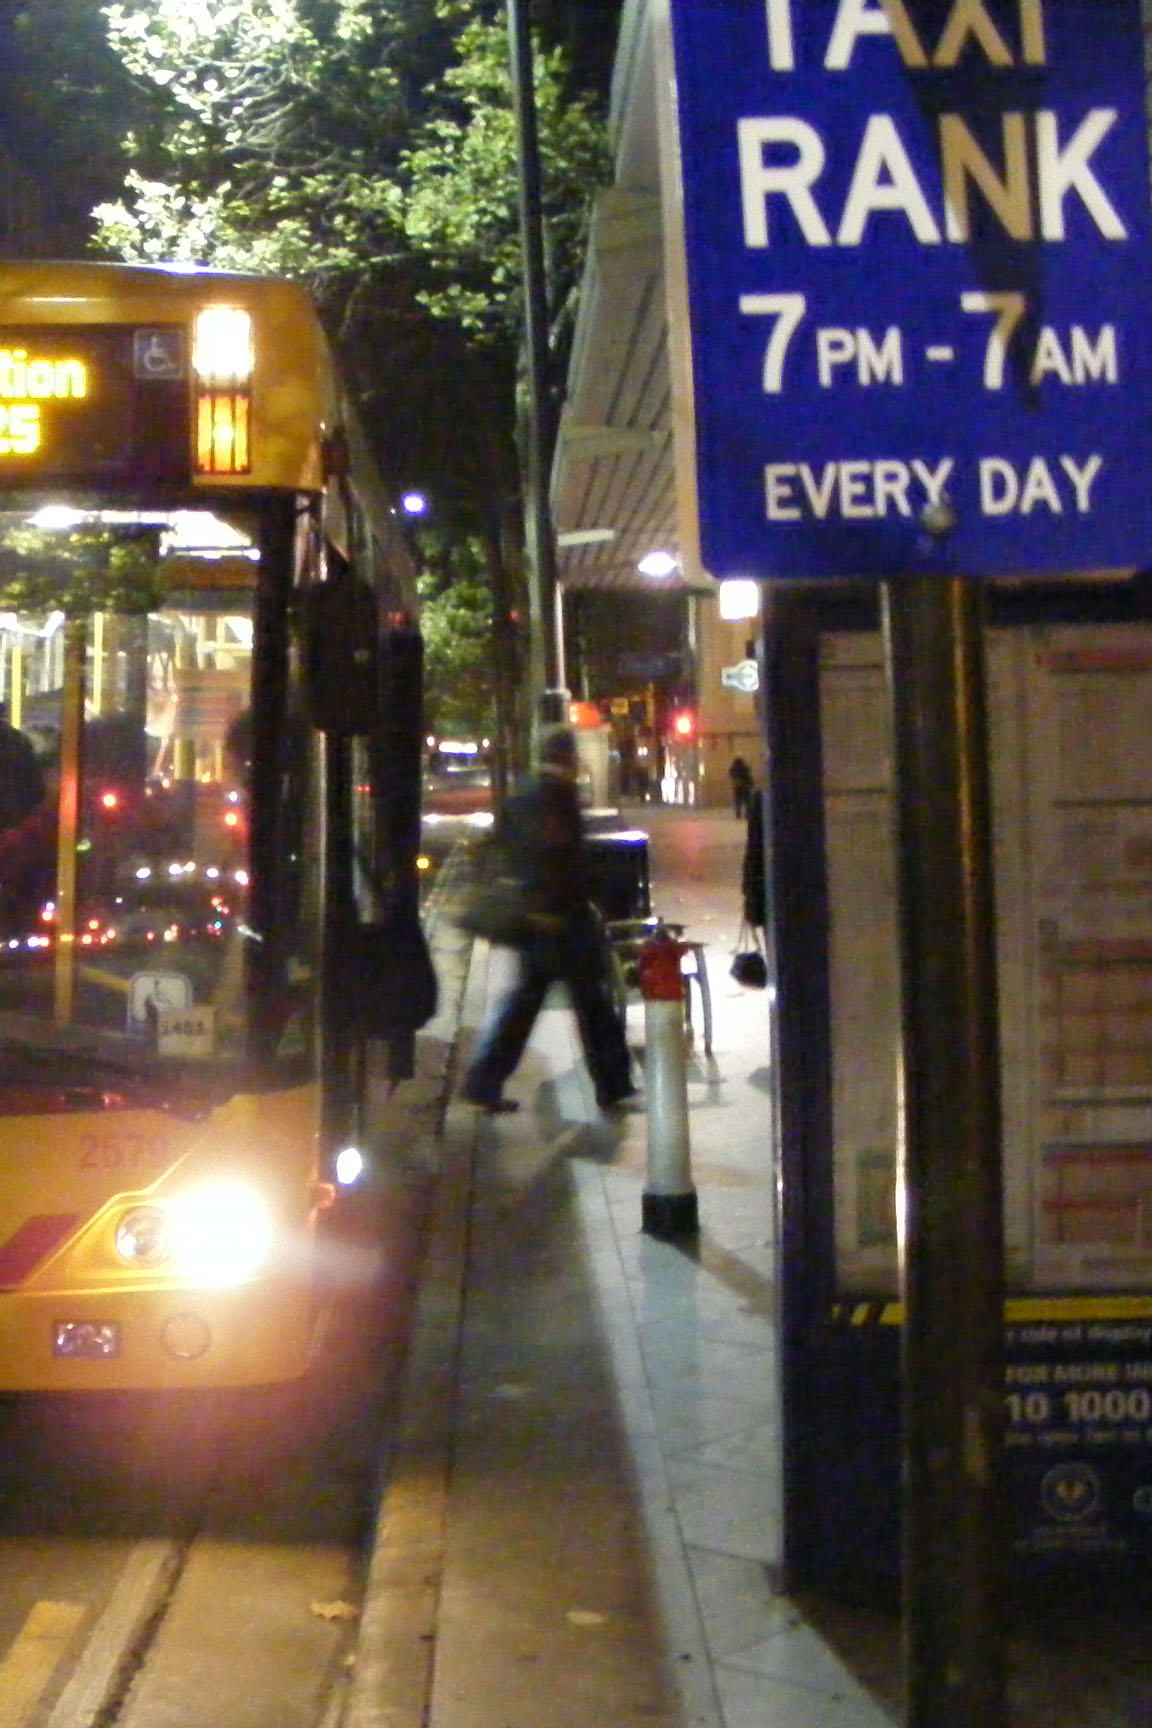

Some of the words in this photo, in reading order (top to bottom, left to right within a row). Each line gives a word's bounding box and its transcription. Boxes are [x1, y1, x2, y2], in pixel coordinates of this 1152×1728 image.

[737, 108, 1128, 248] RANK
[764, 457, 954, 521] EVERY
[978, 455, 1103, 516] DAY
